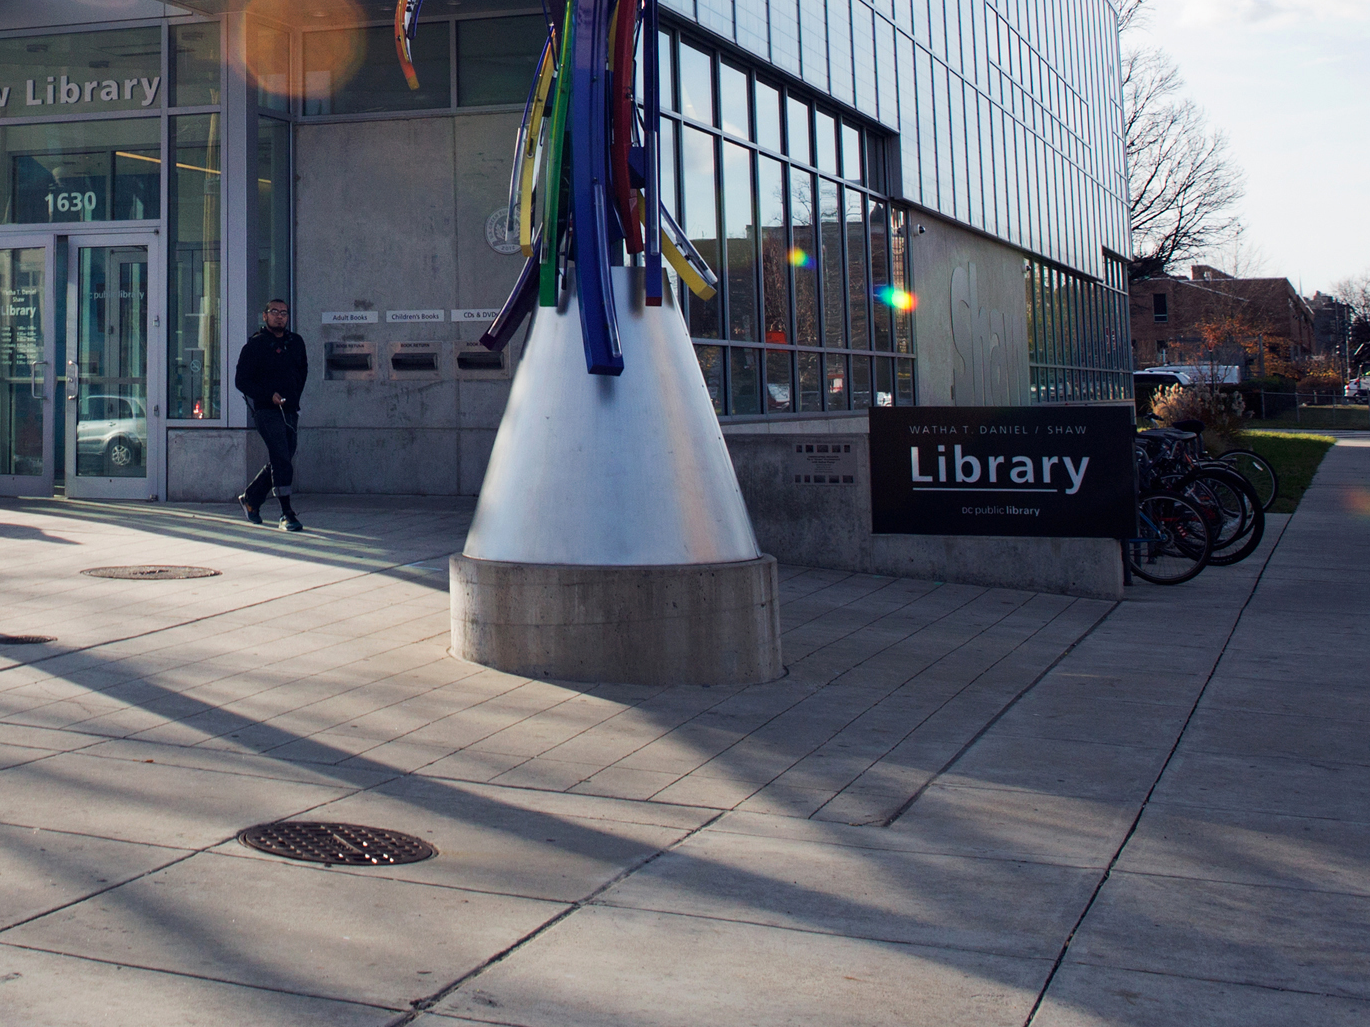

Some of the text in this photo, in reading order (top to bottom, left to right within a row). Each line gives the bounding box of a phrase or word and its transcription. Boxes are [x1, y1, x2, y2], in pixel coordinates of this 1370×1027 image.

[25, 75, 161, 107] Library
[45, 191, 96, 212] 1630
[1, 304, 36, 318] Library
[909, 425, 958, 435] WATHA
[962, 425, 974, 435] T.
[979, 425, 1028, 435] DANIEL
[1047, 425, 1087, 435] SHAW
[910, 444, 1090, 495] Library
[975, 505, 1005, 516] public
[1006, 505, 1040, 517] library
